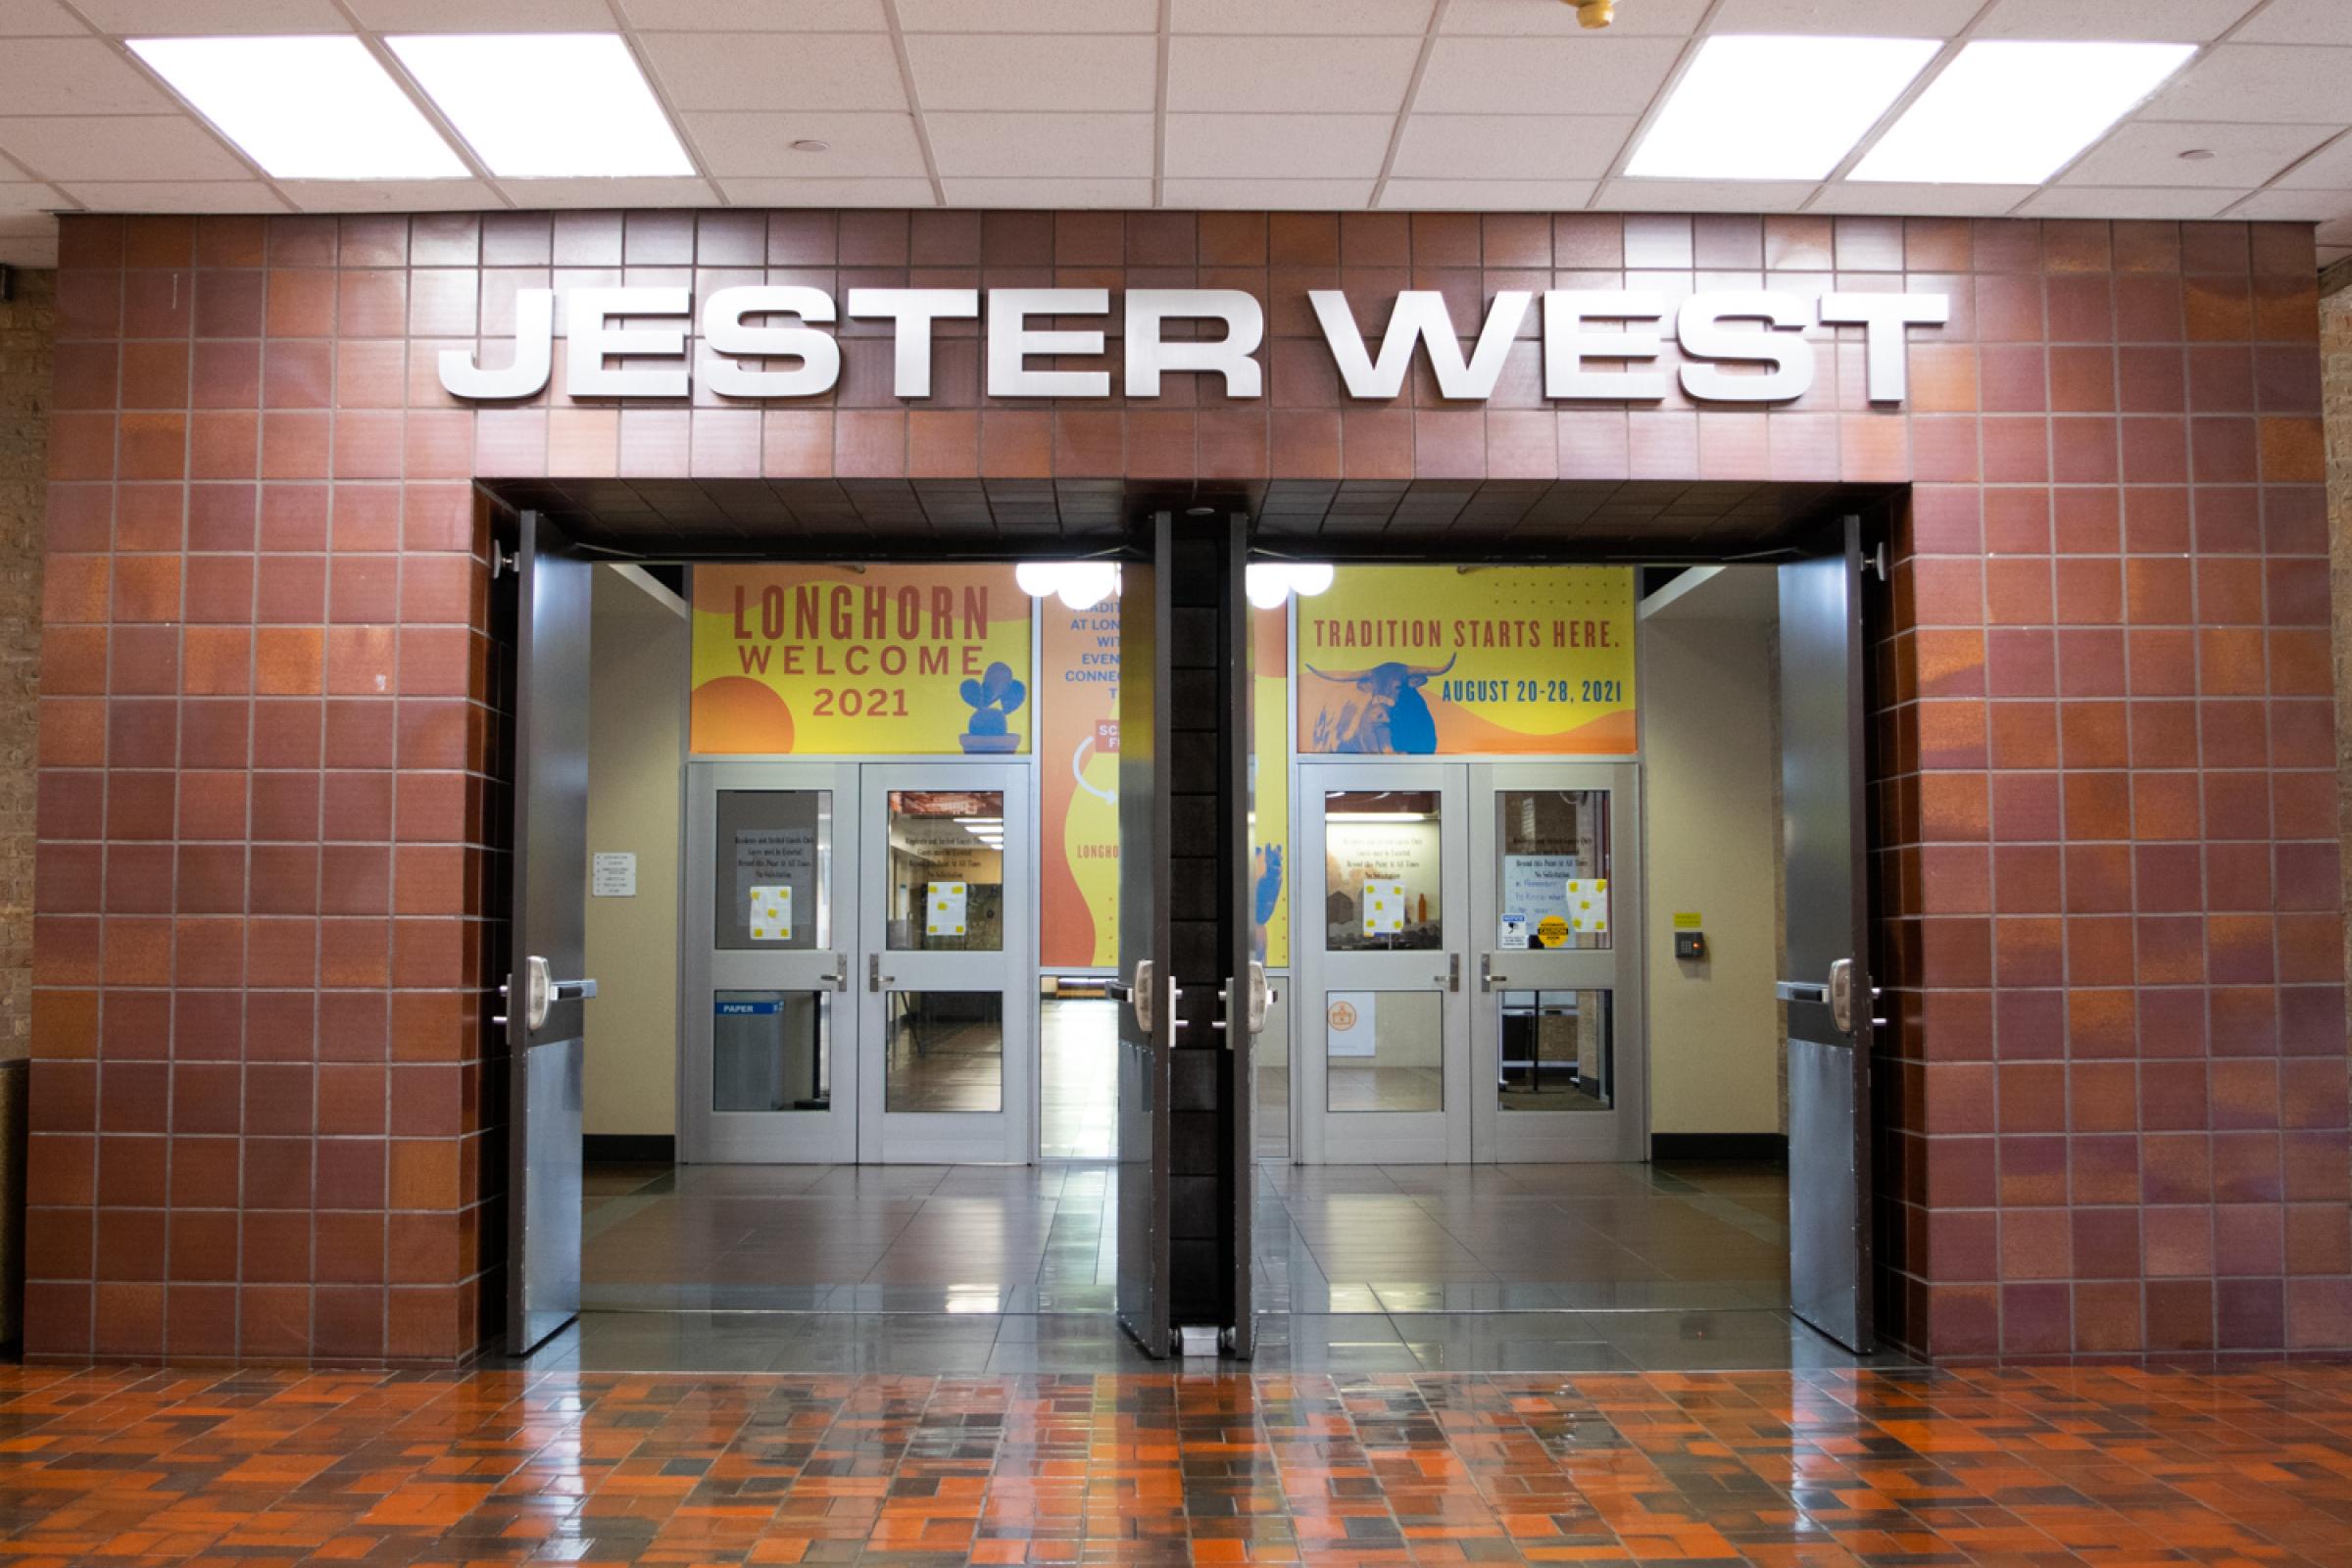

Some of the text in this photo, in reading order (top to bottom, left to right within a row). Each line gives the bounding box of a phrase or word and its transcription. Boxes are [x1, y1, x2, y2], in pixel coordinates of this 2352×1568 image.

[437, 285, 1951, 403] JESTER WEST
[735, 585, 988, 640] LONGHORN
[1070, 618, 1088, 630] AT
[1314, 619, 1620, 648] TRADITION STARTS HERE.
[738, 645, 983, 675] WELCOME
[812, 688, 908, 716] 2021
[1443, 680, 1622, 705] AUGUST 20-28, 2021
[723, 1004, 753, 1013] PAPER
